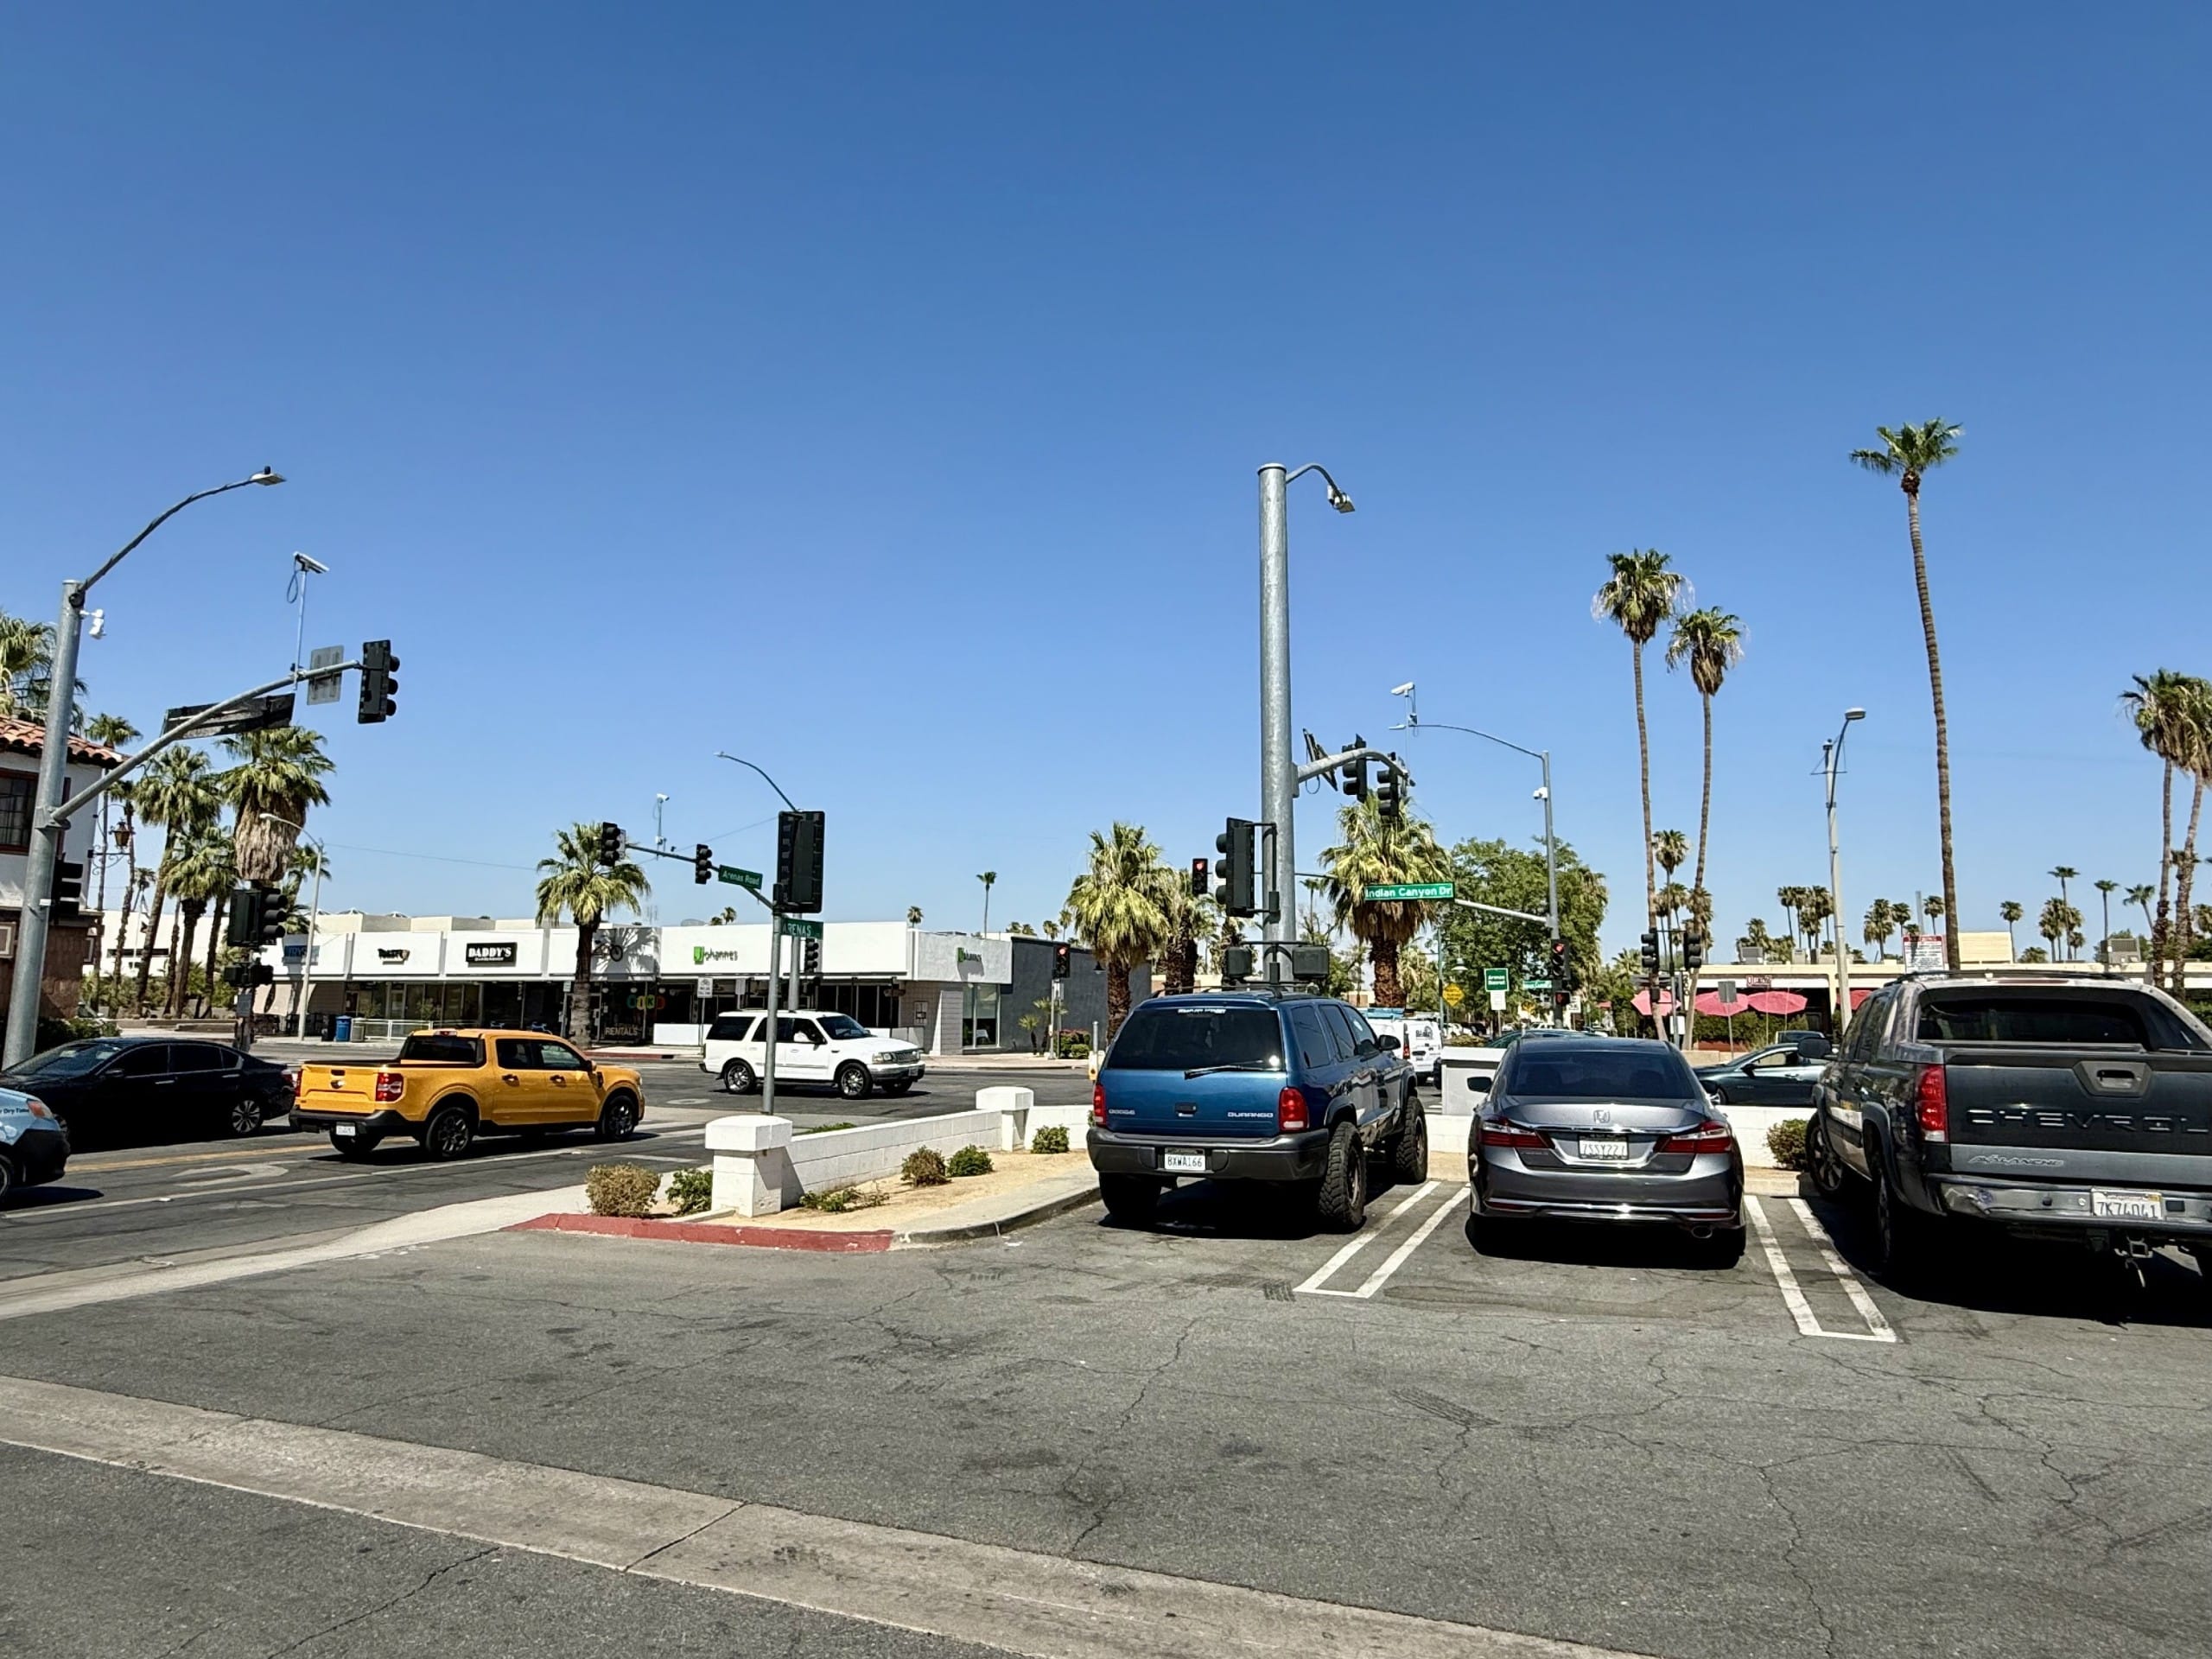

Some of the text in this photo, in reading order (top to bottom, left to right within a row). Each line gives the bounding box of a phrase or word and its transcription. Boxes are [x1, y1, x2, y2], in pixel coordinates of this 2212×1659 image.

[722, 870, 760, 886] Arenas Road
[1365, 887, 1452, 898] Indian Canyon Dr
[782, 922, 812, 937] ARENAS
[468, 947, 512, 957] DADDY'S
[605, 1027, 638, 1036] RENTALS
